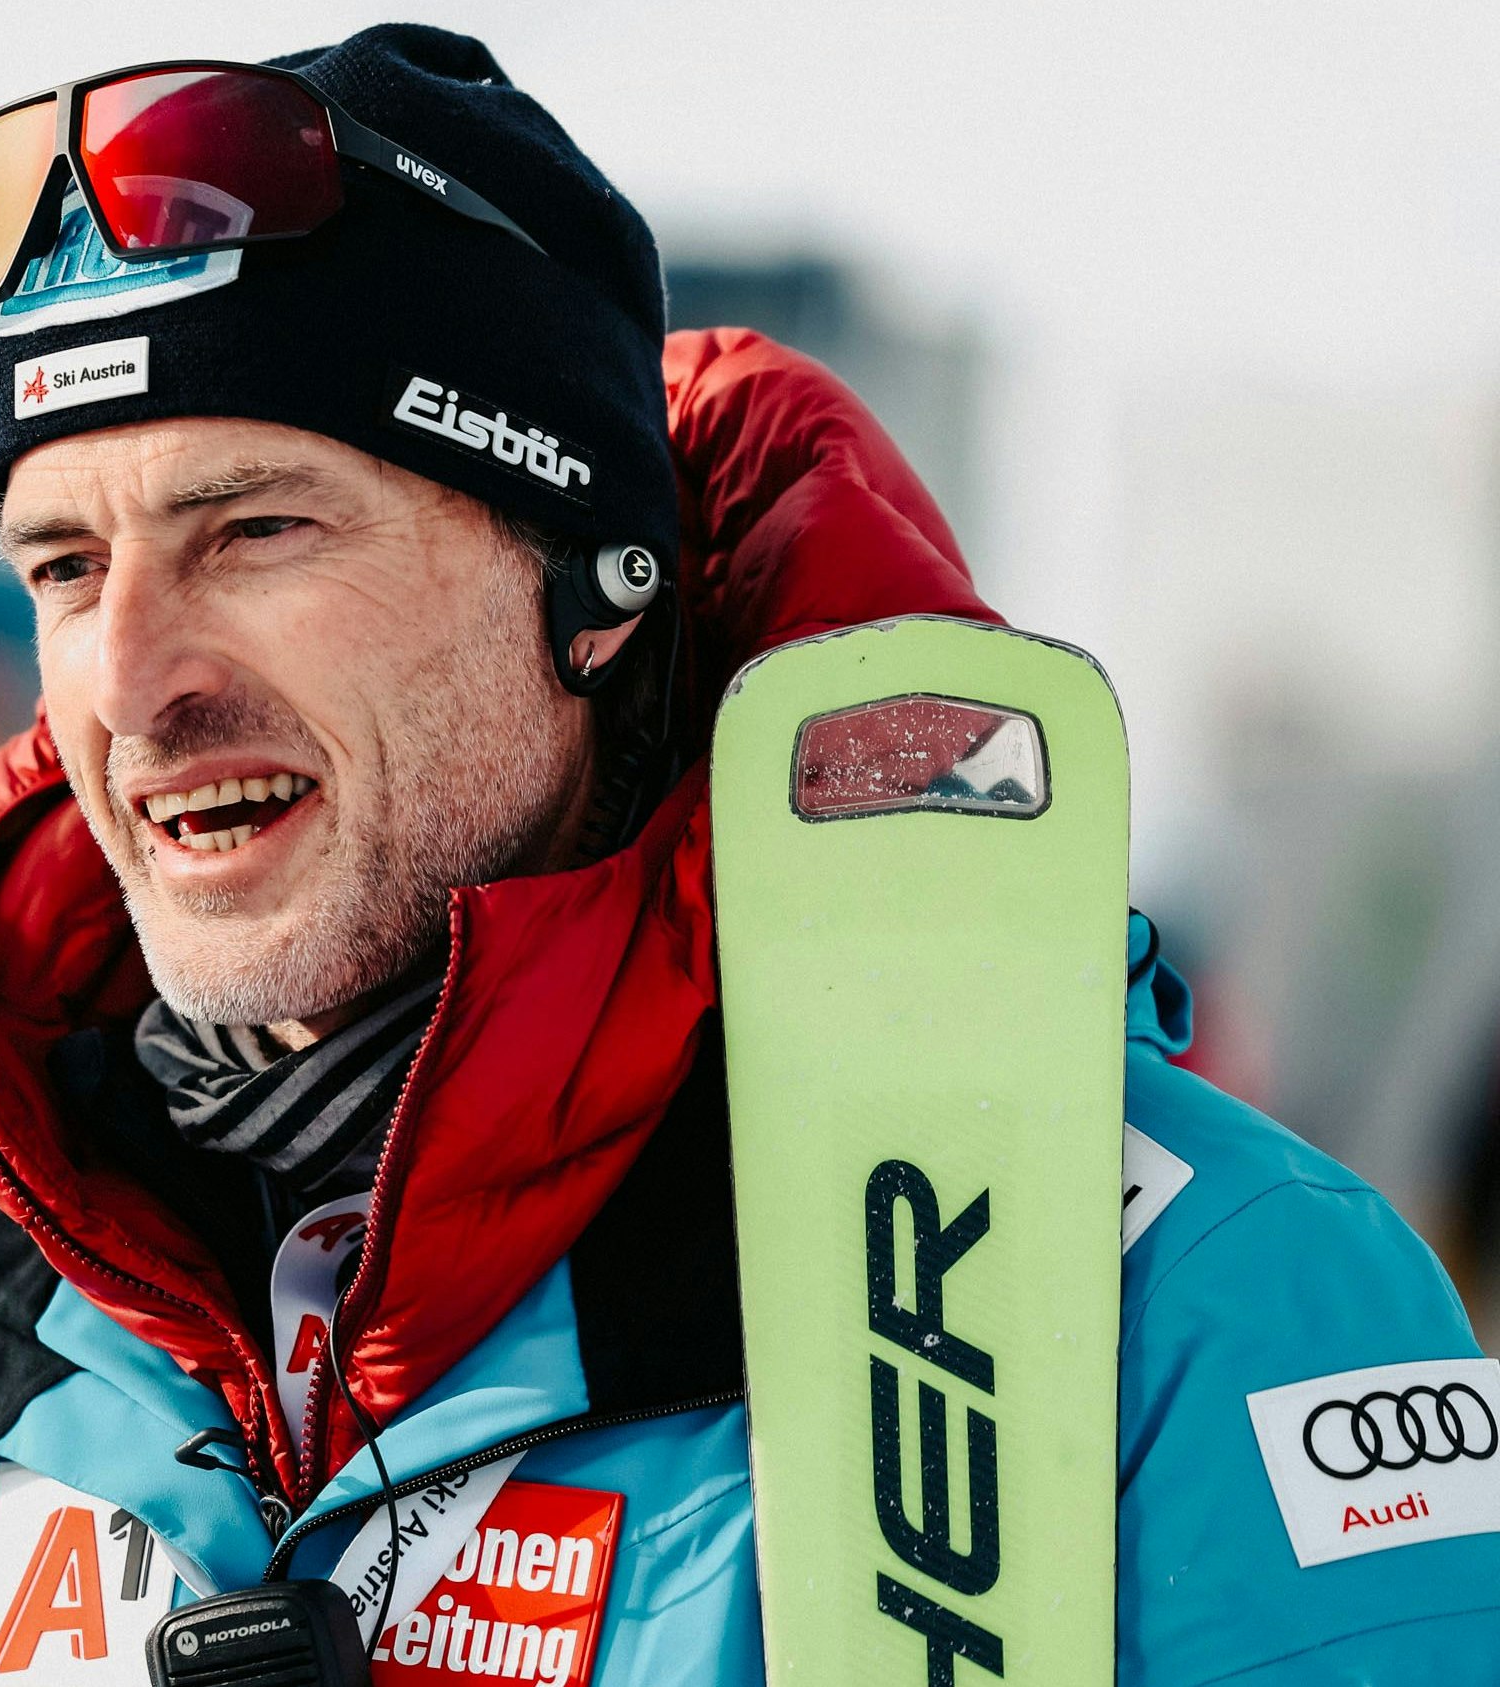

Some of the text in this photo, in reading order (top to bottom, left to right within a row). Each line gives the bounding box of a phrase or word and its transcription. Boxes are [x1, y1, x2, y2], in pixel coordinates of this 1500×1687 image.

[396, 153, 447, 196] uvex
[53, 360, 136, 389] Ski Austria
[393, 376, 591, 489] Eisbär
[1342, 1491, 1430, 1533] Audi
[204, 1617, 292, 1645] MOTOROLA
